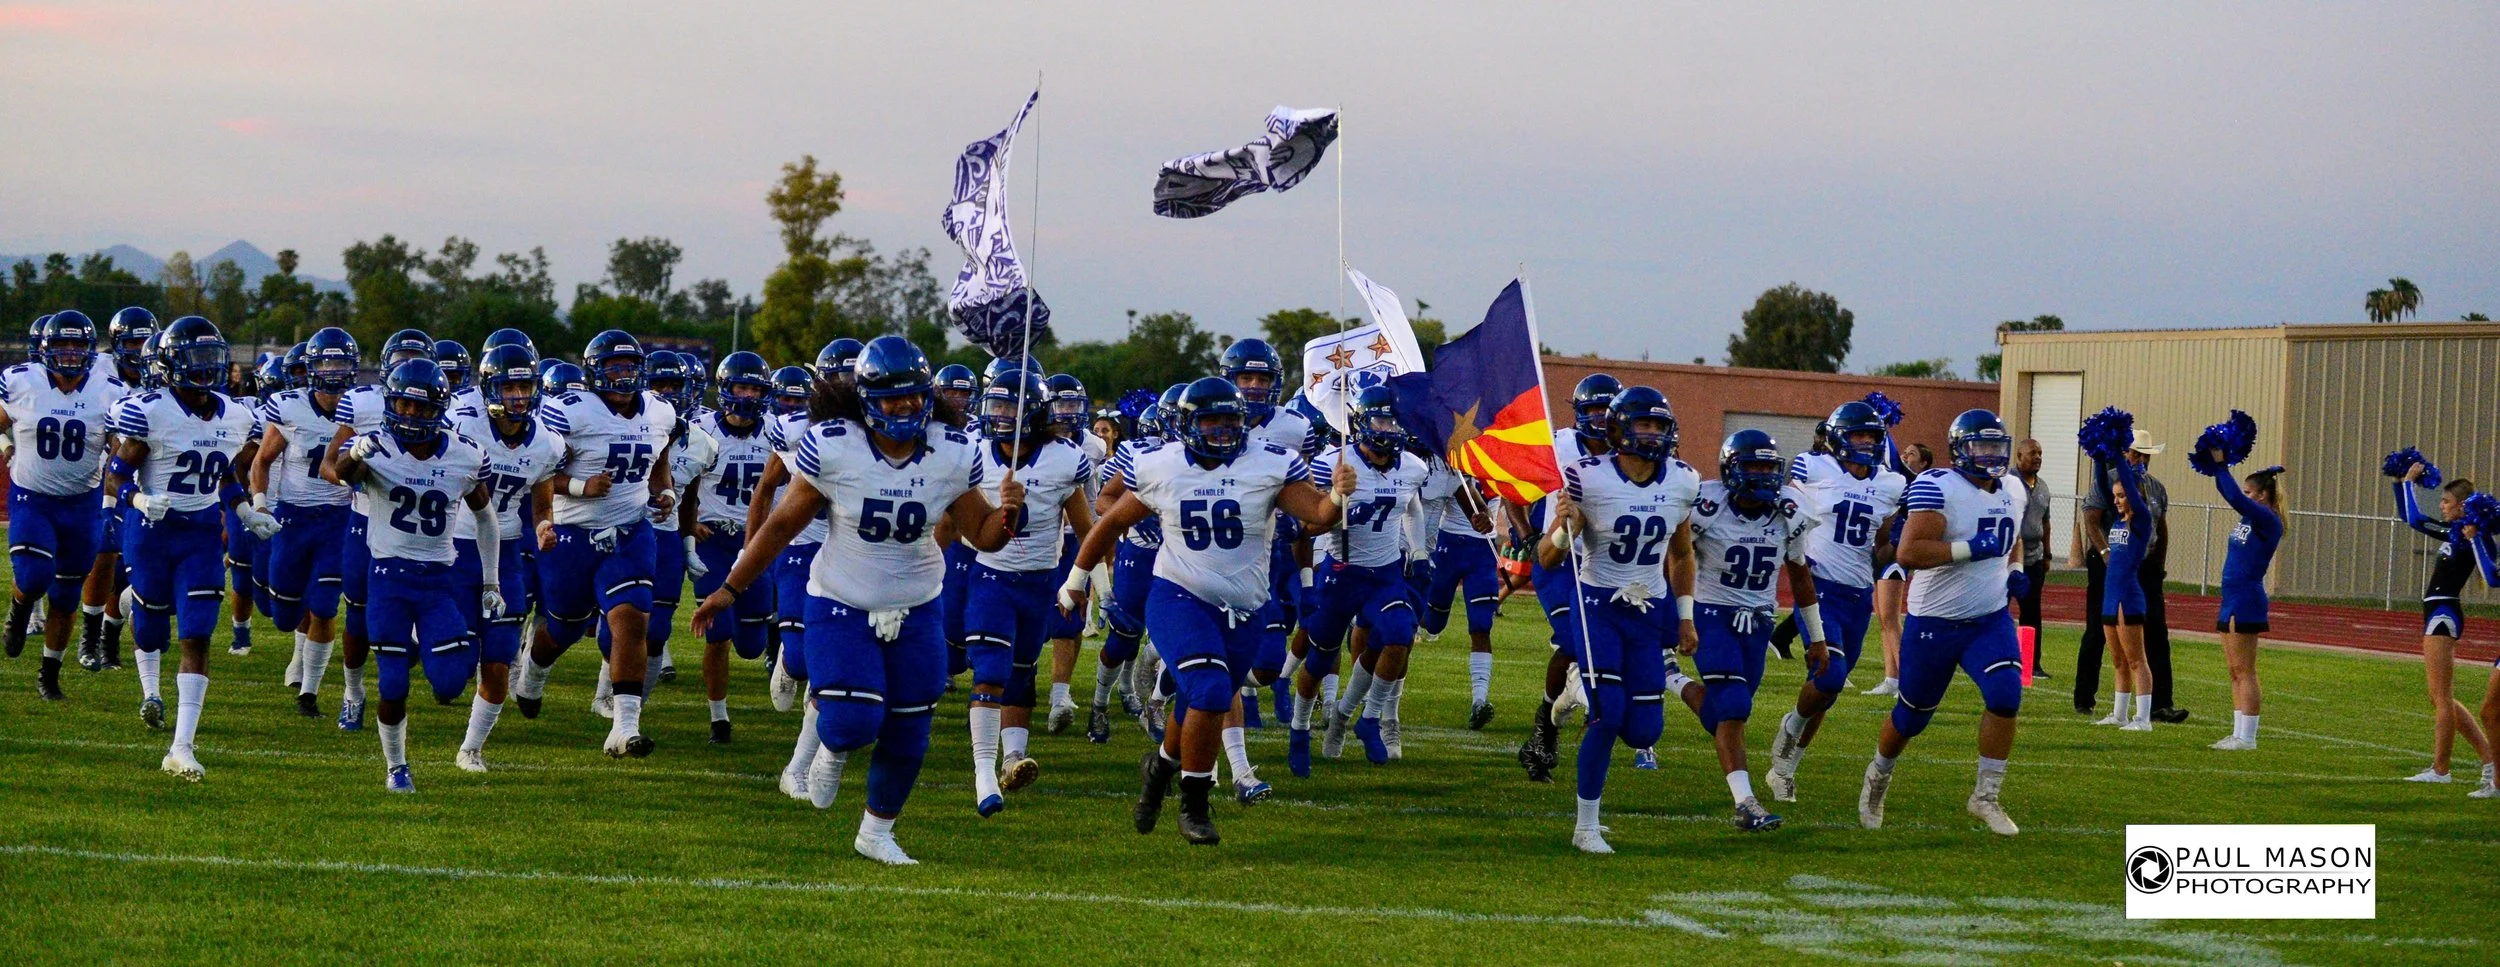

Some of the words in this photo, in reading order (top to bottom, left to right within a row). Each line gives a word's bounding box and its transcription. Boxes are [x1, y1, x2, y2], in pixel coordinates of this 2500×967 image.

[51, 409, 76, 417] CHANDLER
[36, 417, 86, 462] 68
[193, 440, 218, 448] CHANDLER
[167, 450, 229, 495] 20
[405, 477, 434, 487] CHANDLER
[493, 463, 520, 474] CHANDLER
[605, 443, 653, 484] 55
[490, 473, 527, 512] 17
[716, 463, 764, 506] 45
[880, 488, 913, 498] CHANDLER
[1194, 488, 1225, 497] CHANDLER
[1844, 491, 1868, 501] CHANDLER
[389, 486, 449, 537] 29
[857, 497, 927, 544] 58
[1180, 499, 1244, 552] 56
[1629, 505, 1656, 513] CHANDLER
[1832, 500, 1873, 547] 15
[1609, 515, 1667, 566] 32
[1720, 545, 1778, 591] 35
